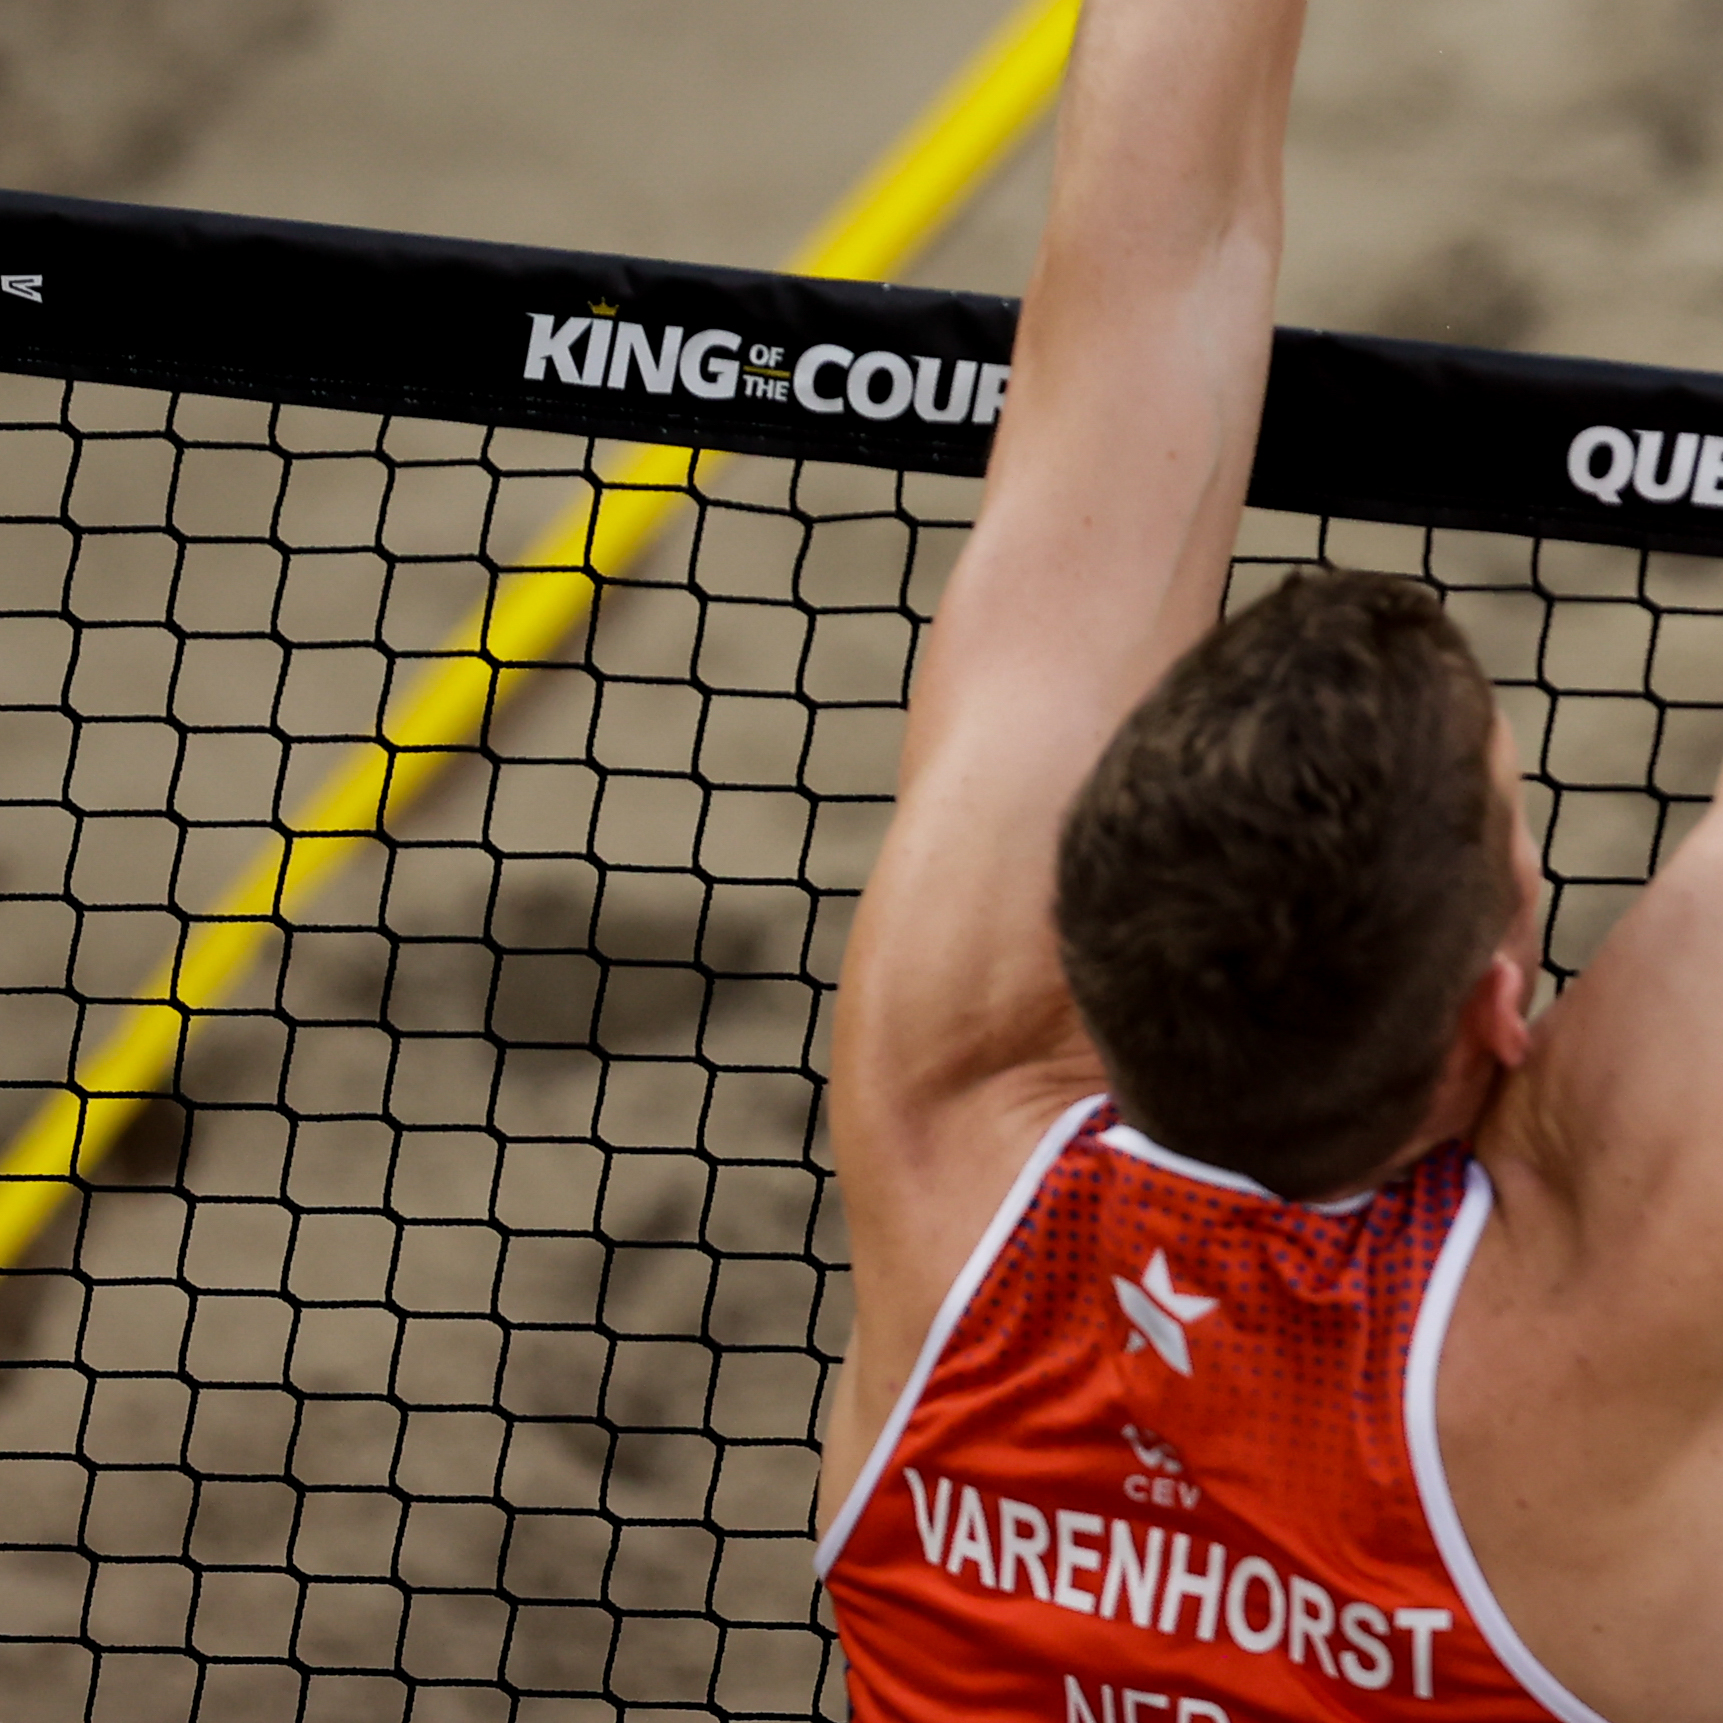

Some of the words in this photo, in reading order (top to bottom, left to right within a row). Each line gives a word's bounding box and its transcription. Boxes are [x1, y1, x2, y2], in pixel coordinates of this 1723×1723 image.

[523, 312, 742, 400] KING
[748, 343, 786, 369] OF
[793, 343, 1012, 425] COUR
[743, 374, 789, 403] THE
[1123, 1473, 1201, 1510] CEV
[904, 1466, 1453, 1701] VARENHORST
